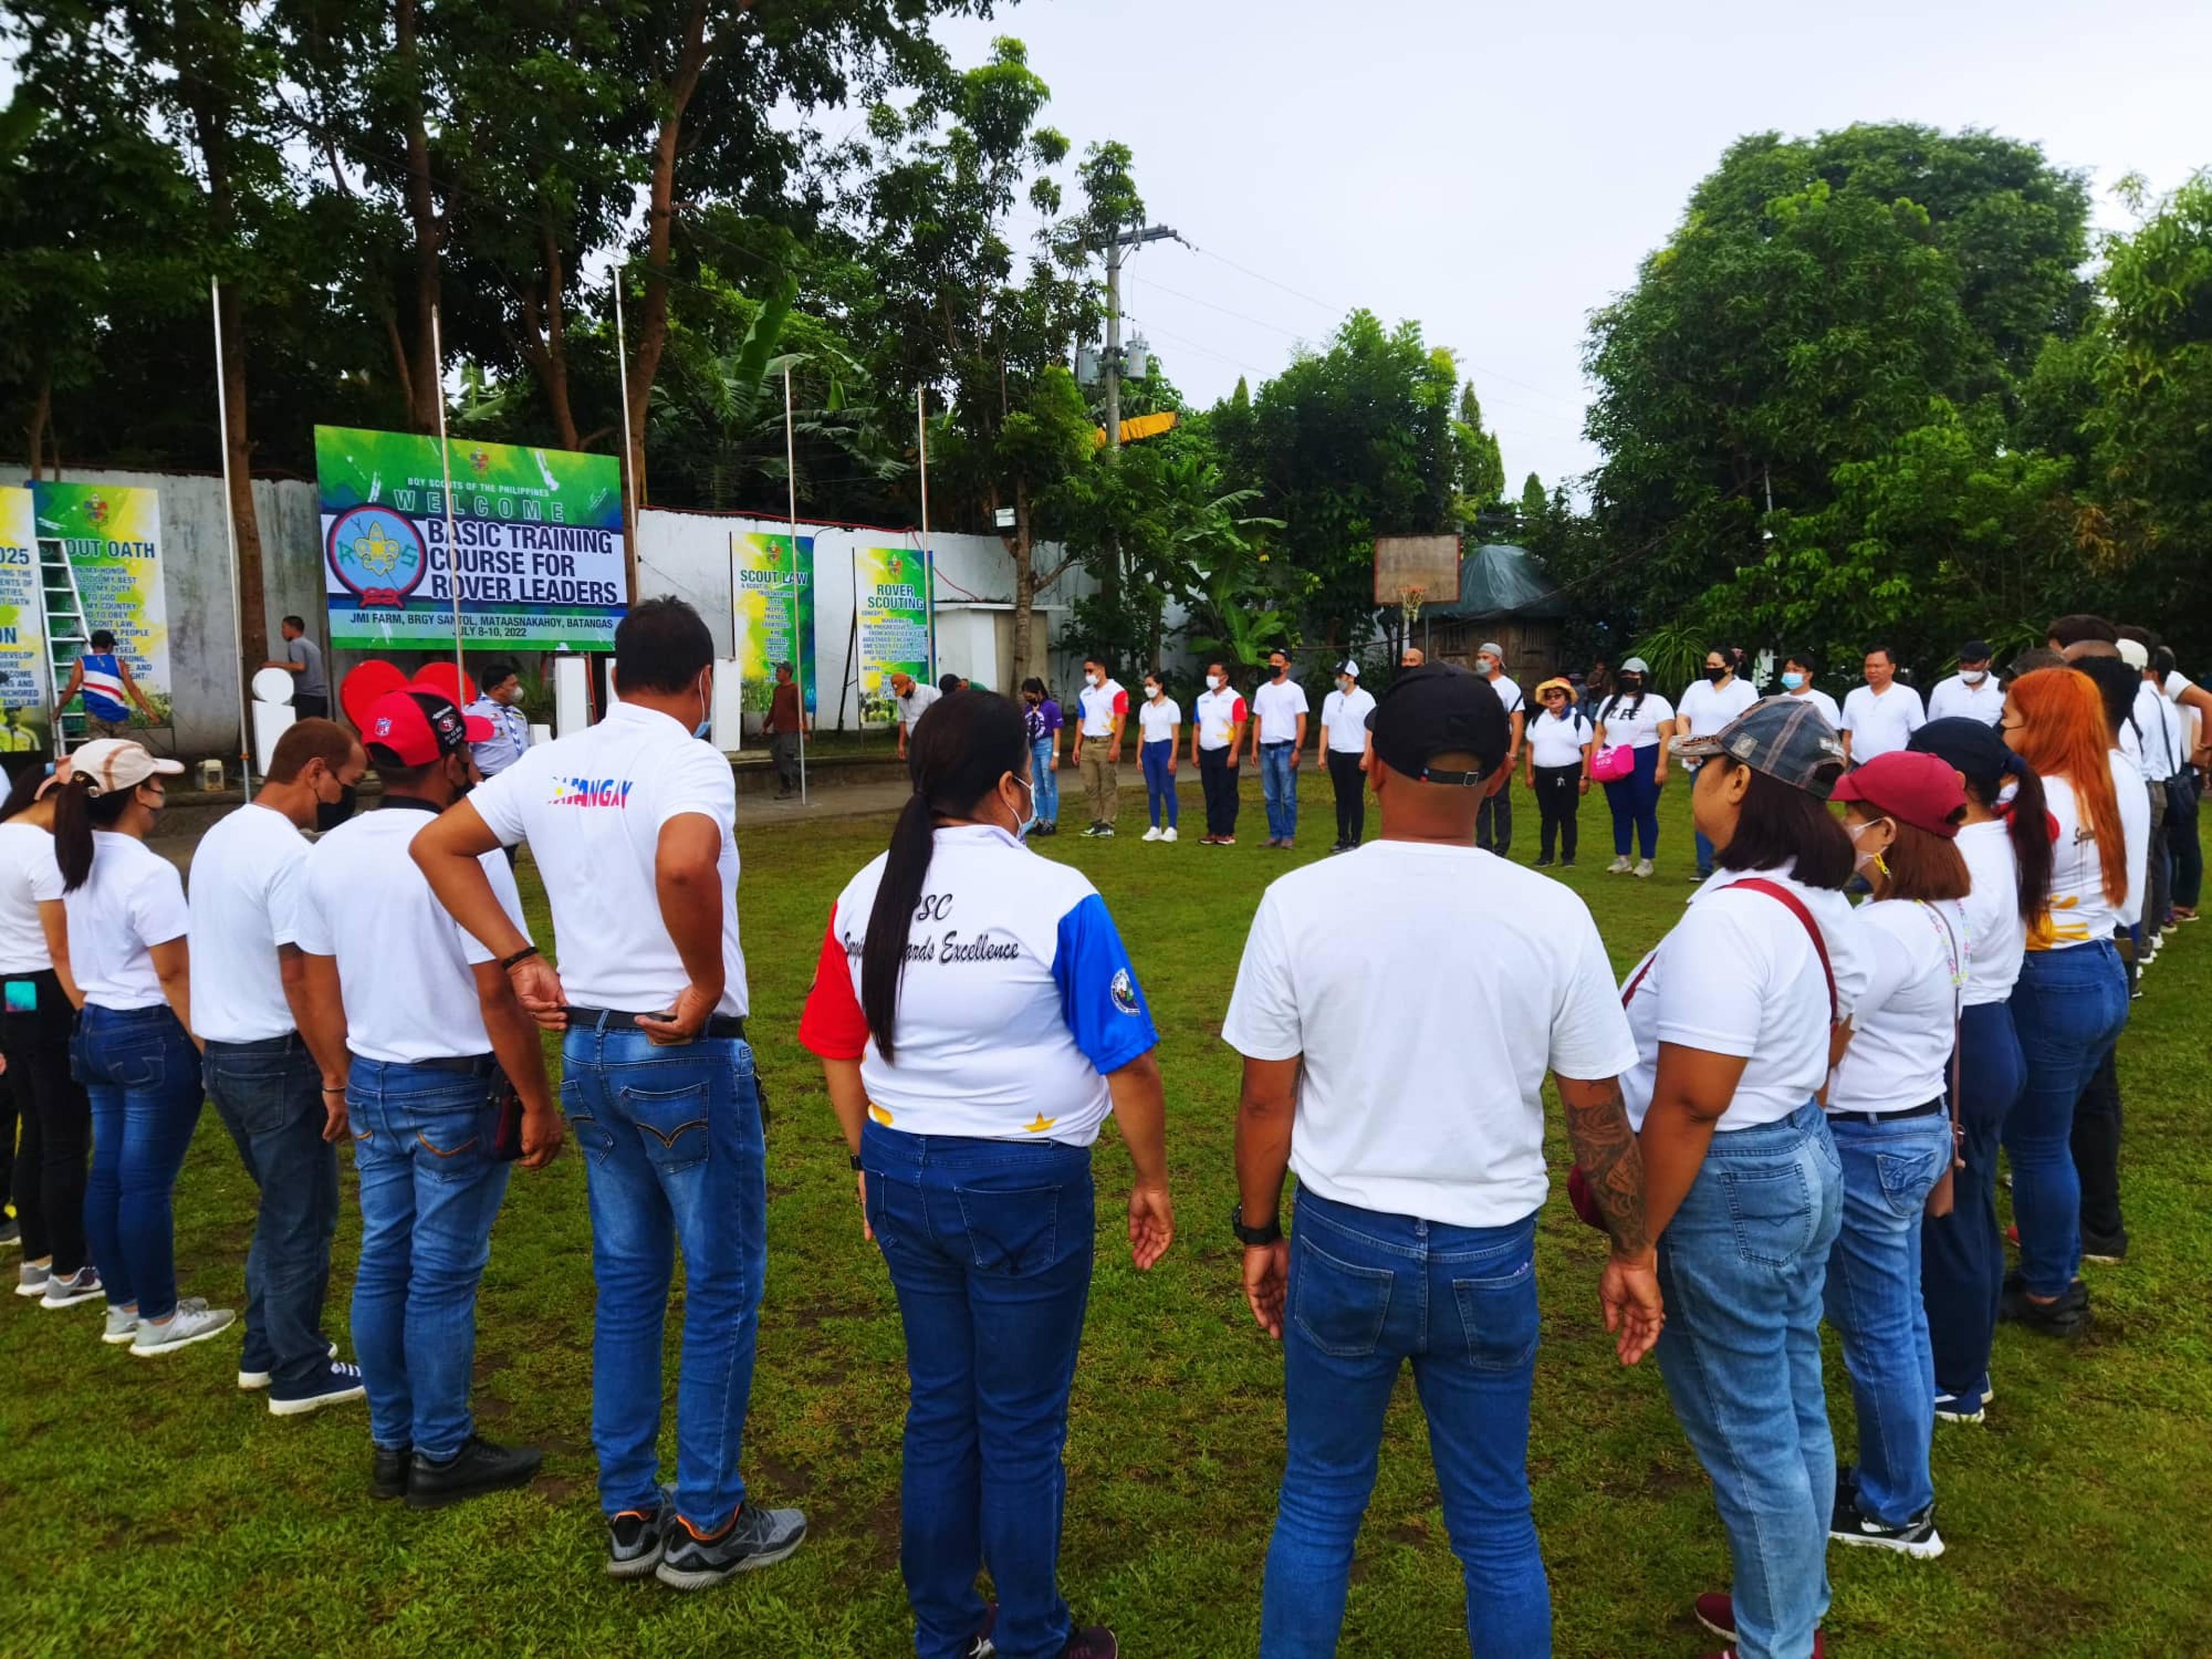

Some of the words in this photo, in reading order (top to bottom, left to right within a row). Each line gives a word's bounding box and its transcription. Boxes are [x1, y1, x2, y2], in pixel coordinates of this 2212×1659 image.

[408, 478, 425, 486] BOY
[480, 484, 495, 492] THE
[498, 485, 549, 497] PHILIPPINES
[394, 490, 563, 522] WELCOME
[427, 519, 501, 547] BASIC
[507, 525, 612, 553] TRAINING
[108, 541, 155, 558] OATH
[430, 547, 525, 574] COURSE
[532, 552, 575, 577] FOR
[740, 569, 778, 582] SCOUT
[783, 572, 807, 584] LAW
[431, 574, 512, 600] ROVER
[520, 577, 618, 604] LEADERS
[877, 584, 913, 596] ROVER
[868, 597, 923, 609] SCOUTING
[350, 613, 369, 623] JMI
[372, 613, 406, 626] FARM,
[408, 615, 434, 624] BRGY
[567, 618, 613, 628] BATANGAS
[505, 628, 527, 637] 2022
[940, 929, 1019, 965] Excellence
